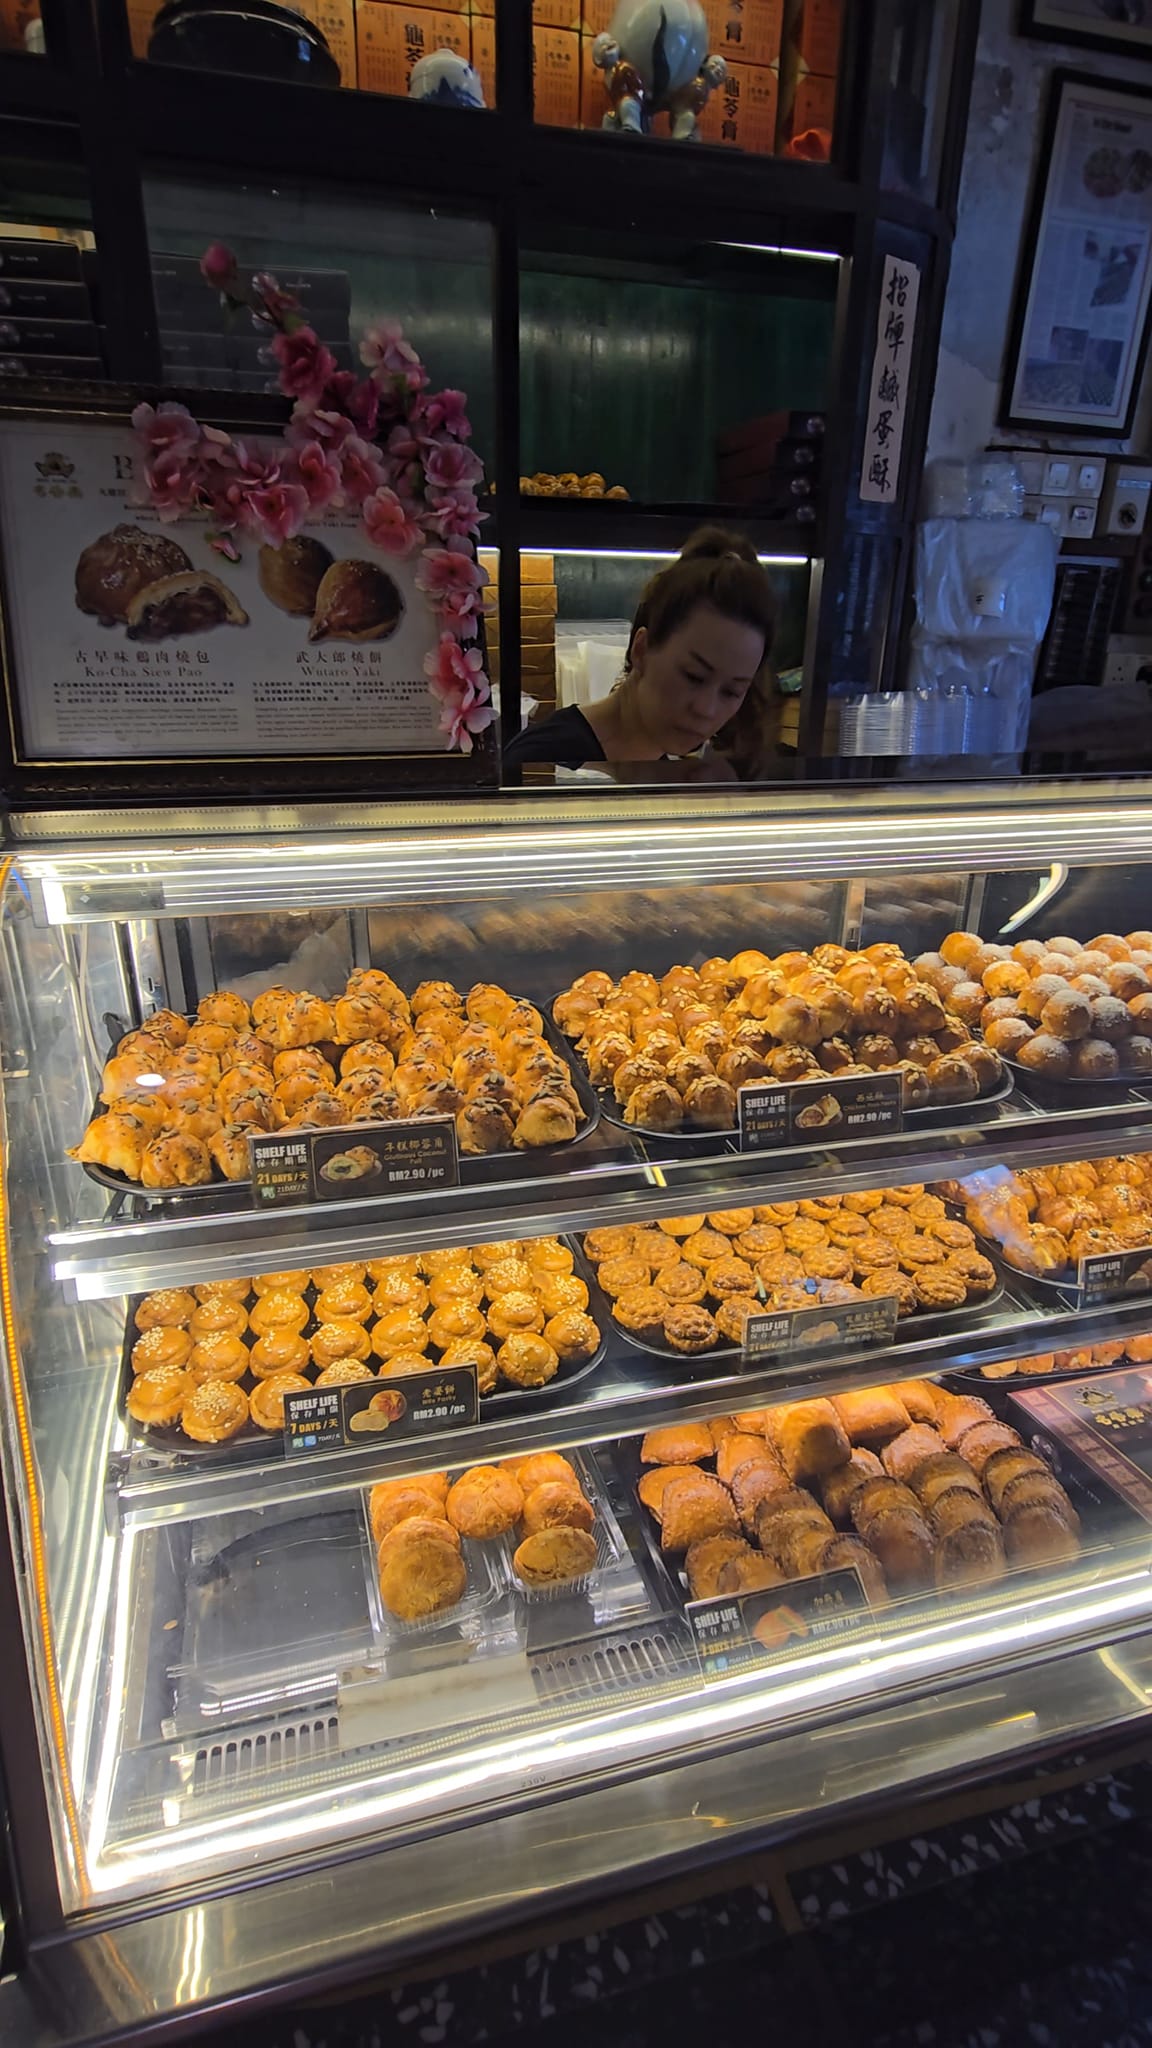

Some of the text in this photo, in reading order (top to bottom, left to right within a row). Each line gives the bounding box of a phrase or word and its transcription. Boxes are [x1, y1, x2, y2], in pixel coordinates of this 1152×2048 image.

[85, 666, 203, 678] Ko-Cha Siew Pao
[301, 665, 381, 677] Wutaro Yaki
[745, 1095, 786, 1108] SHELF LIFE
[746, 1120, 756, 1132] 21
[255, 1144, 307, 1159] SHELF LIFE
[257, 1173, 270, 1185] 21
[271, 1173, 293, 1183] DAYS
[389, 1167, 445, 1182] RM2.90 /pc
[1088, 1261, 1121, 1273] SHELF LIFE
[750, 1319, 790, 1333] SHELF LIFE
[289, 1394, 339, 1412] SHELF LIFE
[449, 1404, 466, 1416] /pc
[290, 1423, 297, 1435] 7
[298, 1421, 322, 1433] DAYS
[328, 1418, 339, 1428] 天
[694, 1607, 739, 1629] SHELF LIFE
